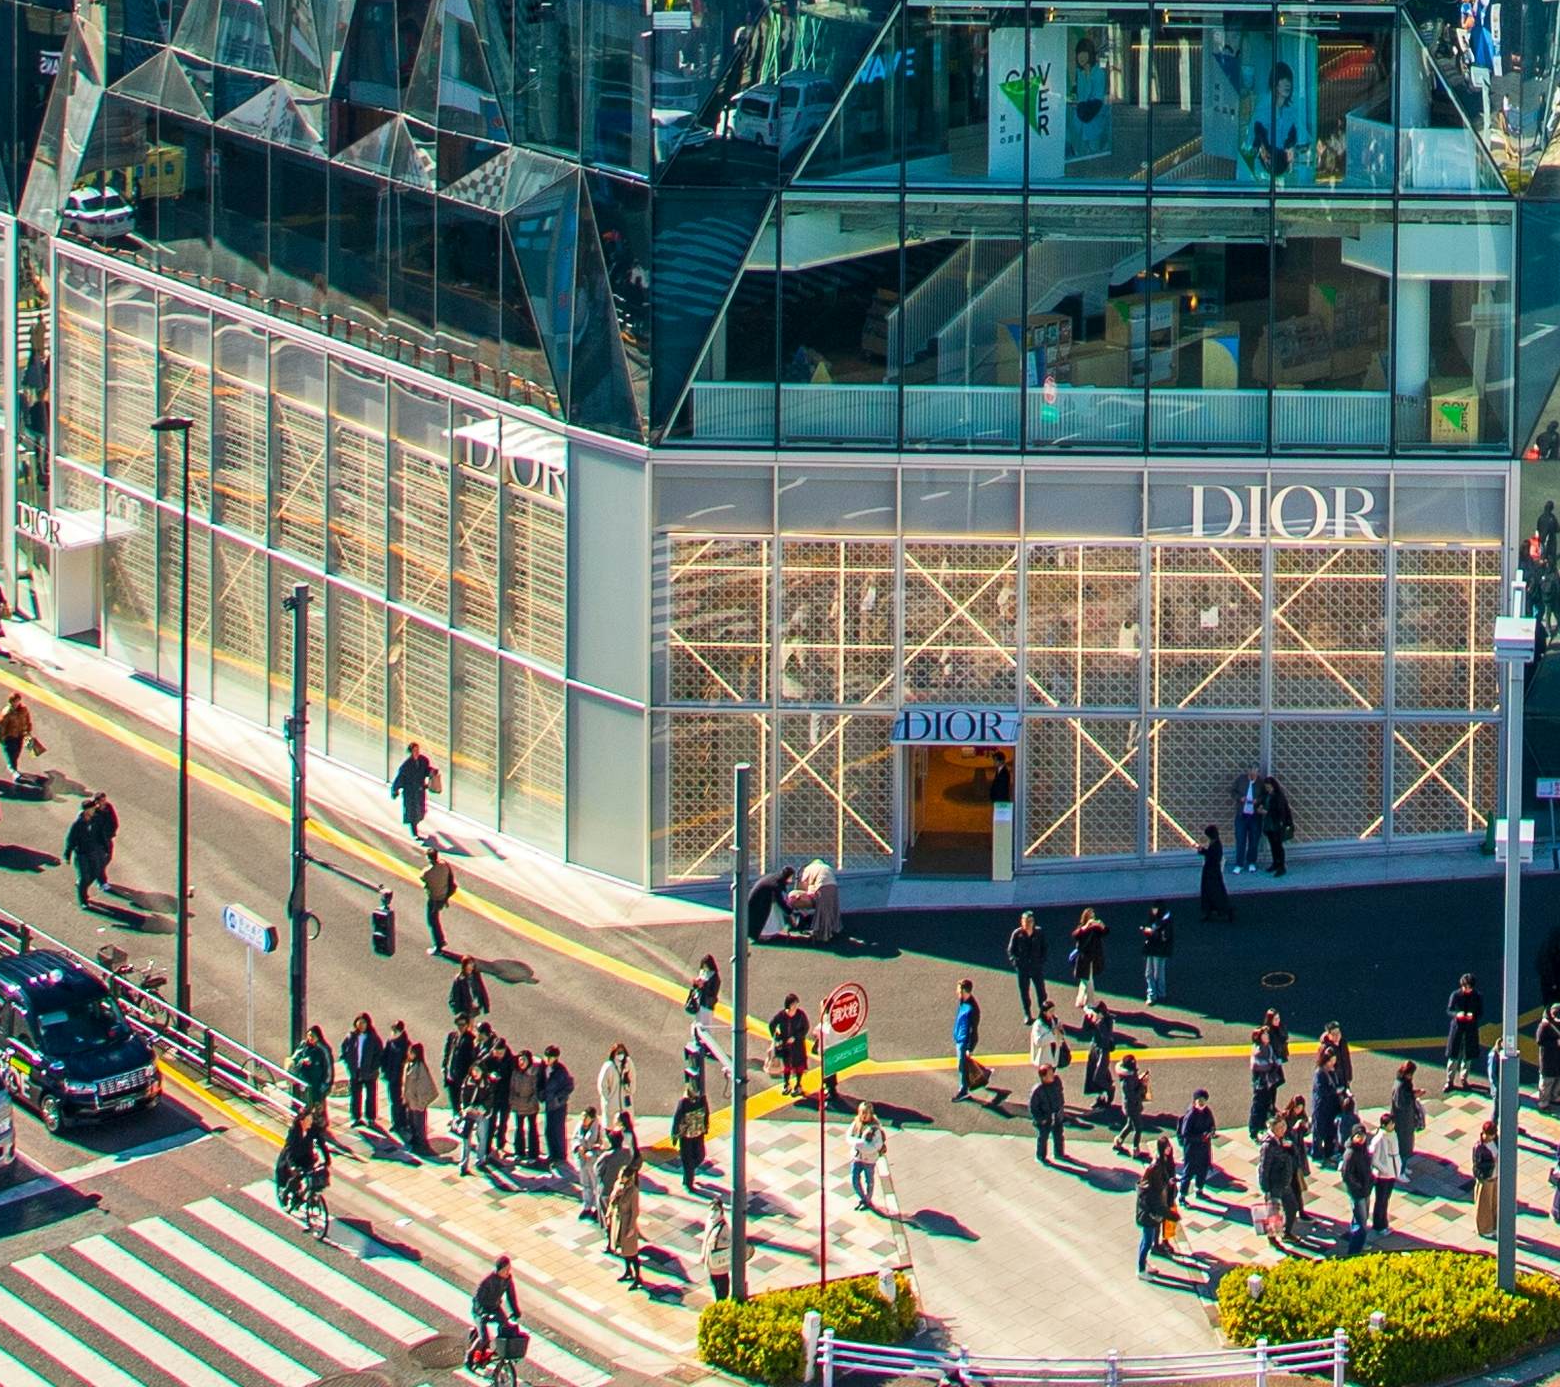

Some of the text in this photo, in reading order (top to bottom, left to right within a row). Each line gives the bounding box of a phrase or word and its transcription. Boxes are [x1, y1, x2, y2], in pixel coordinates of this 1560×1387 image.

[16, 502, 64, 548] DIOR
[1187, 483, 1385, 541] DIOR
[902, 710, 1012, 743] DIOR
